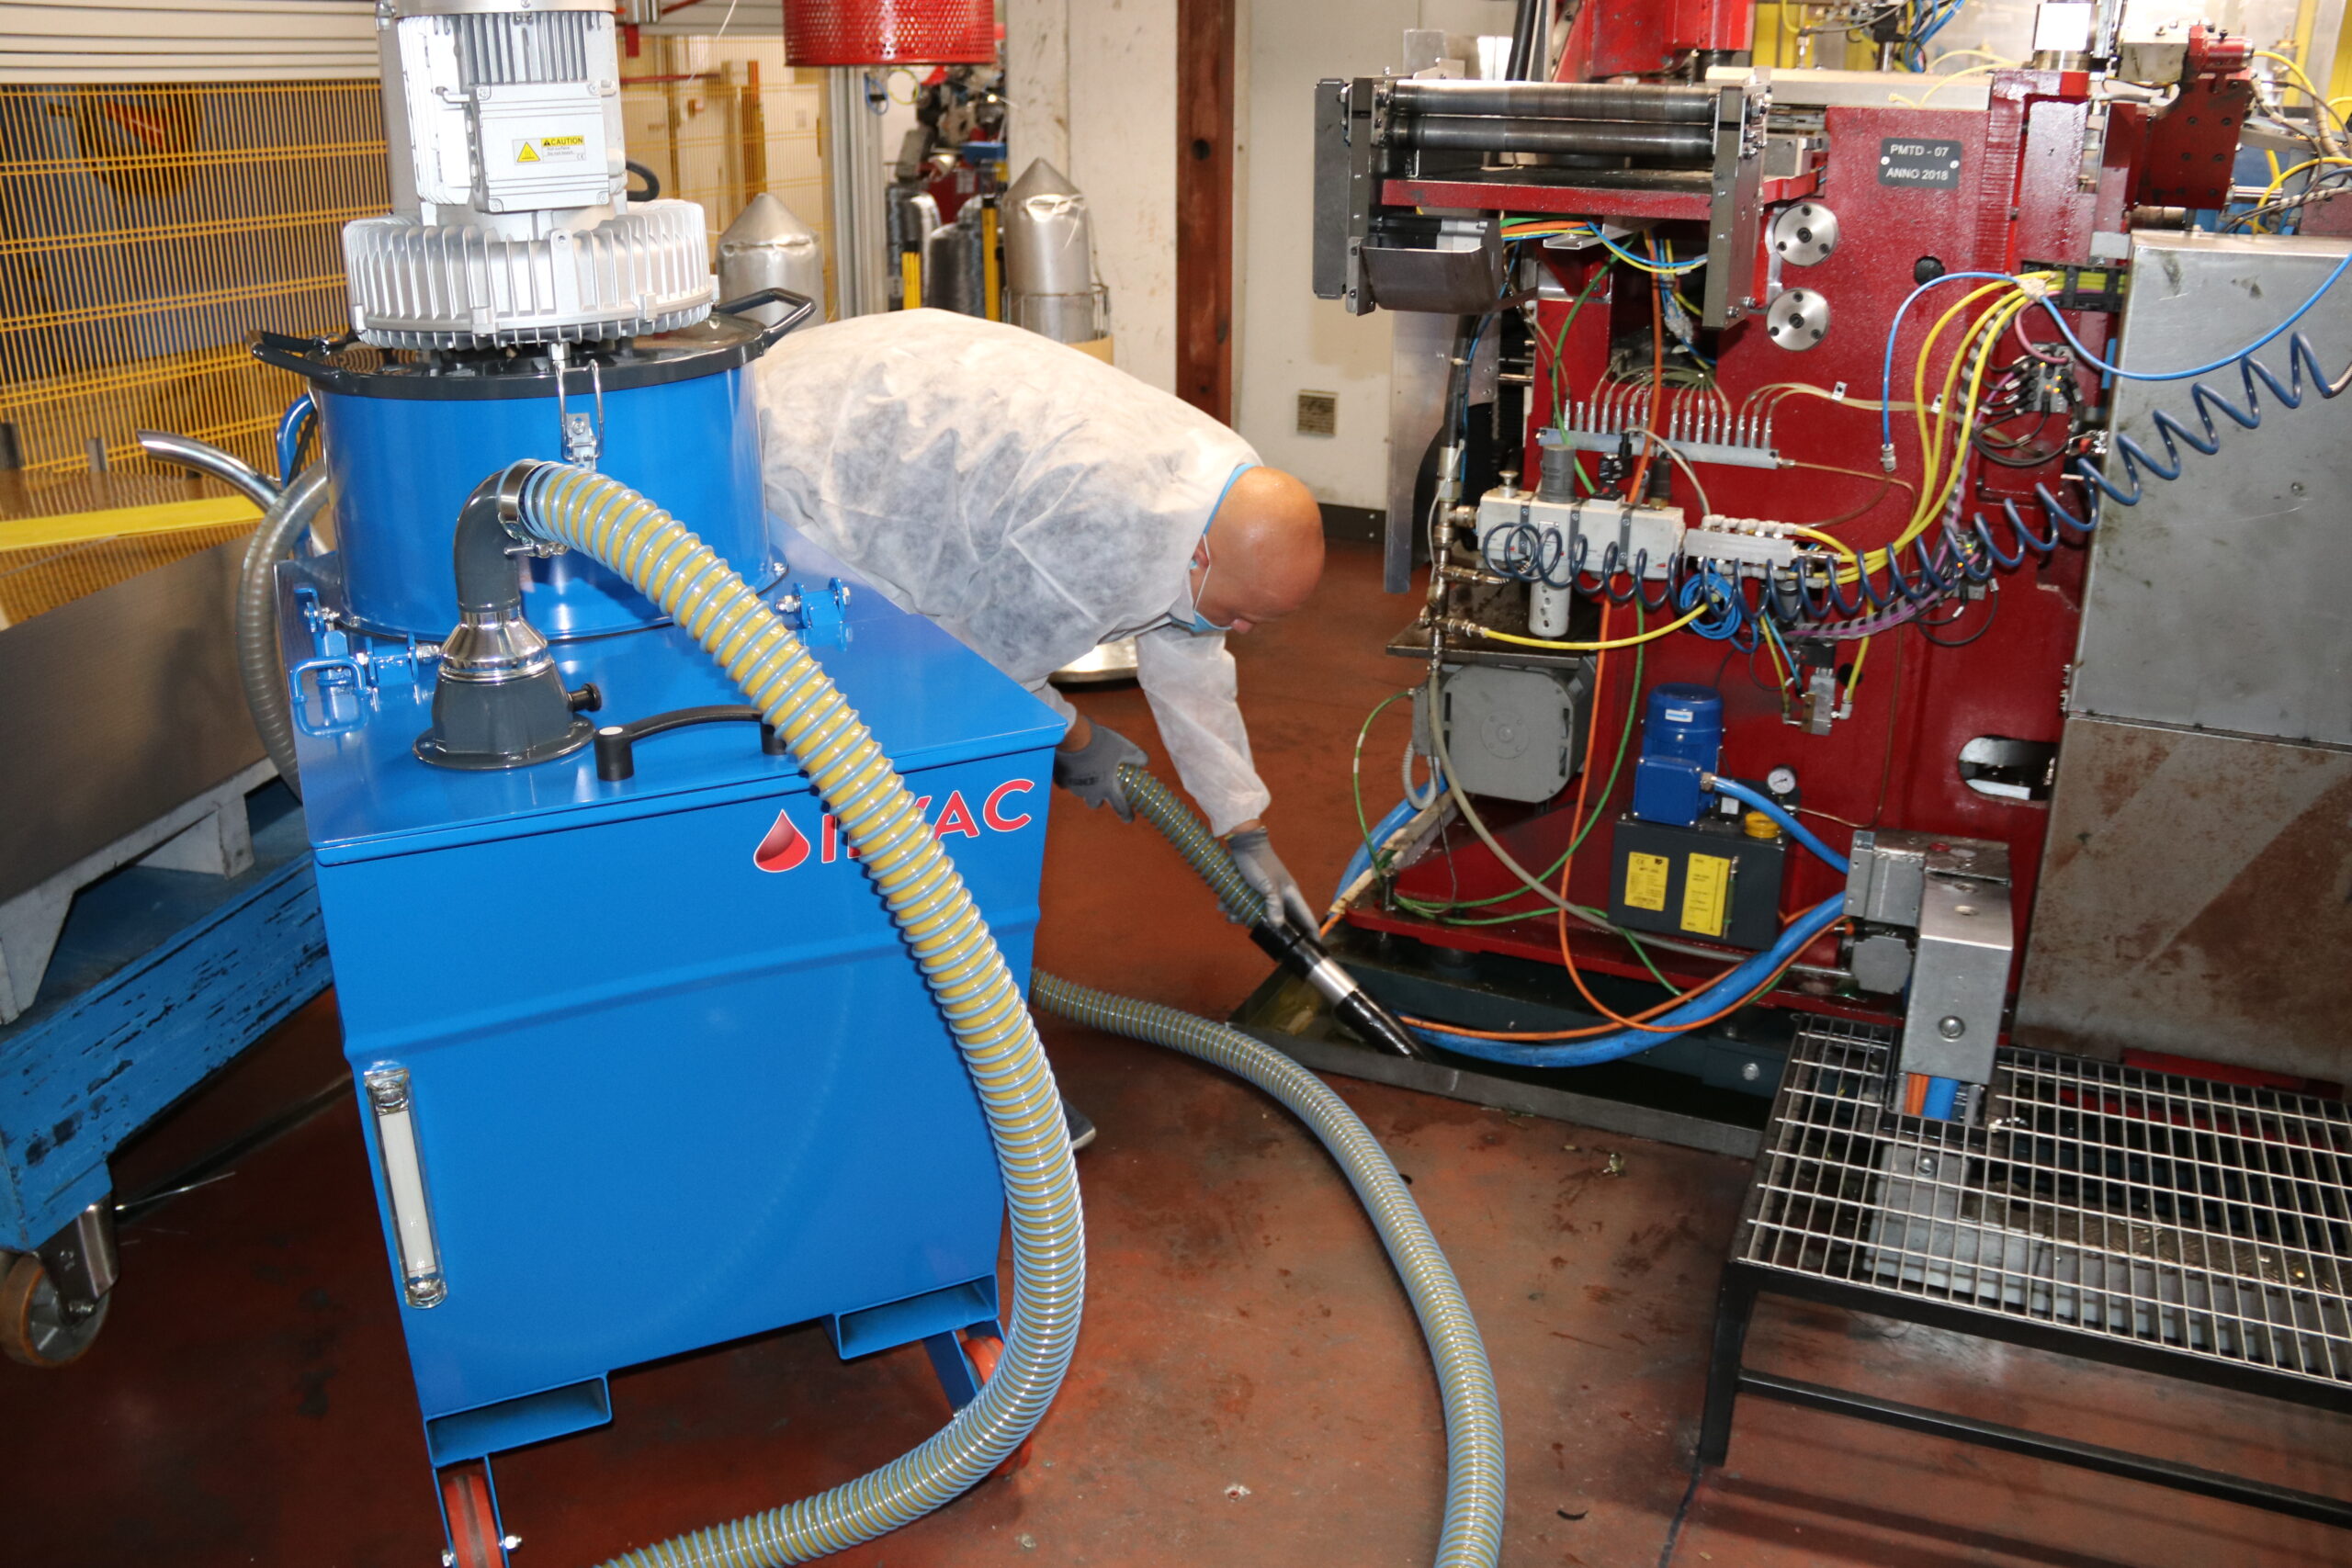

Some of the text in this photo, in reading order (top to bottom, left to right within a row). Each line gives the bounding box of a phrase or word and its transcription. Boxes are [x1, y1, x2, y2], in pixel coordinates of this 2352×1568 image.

[1890, 143, 1925, 156] PMTD
[1934, 146, 1950, 157] 07
[1885, 167, 1949, 181] ANNO 2018
